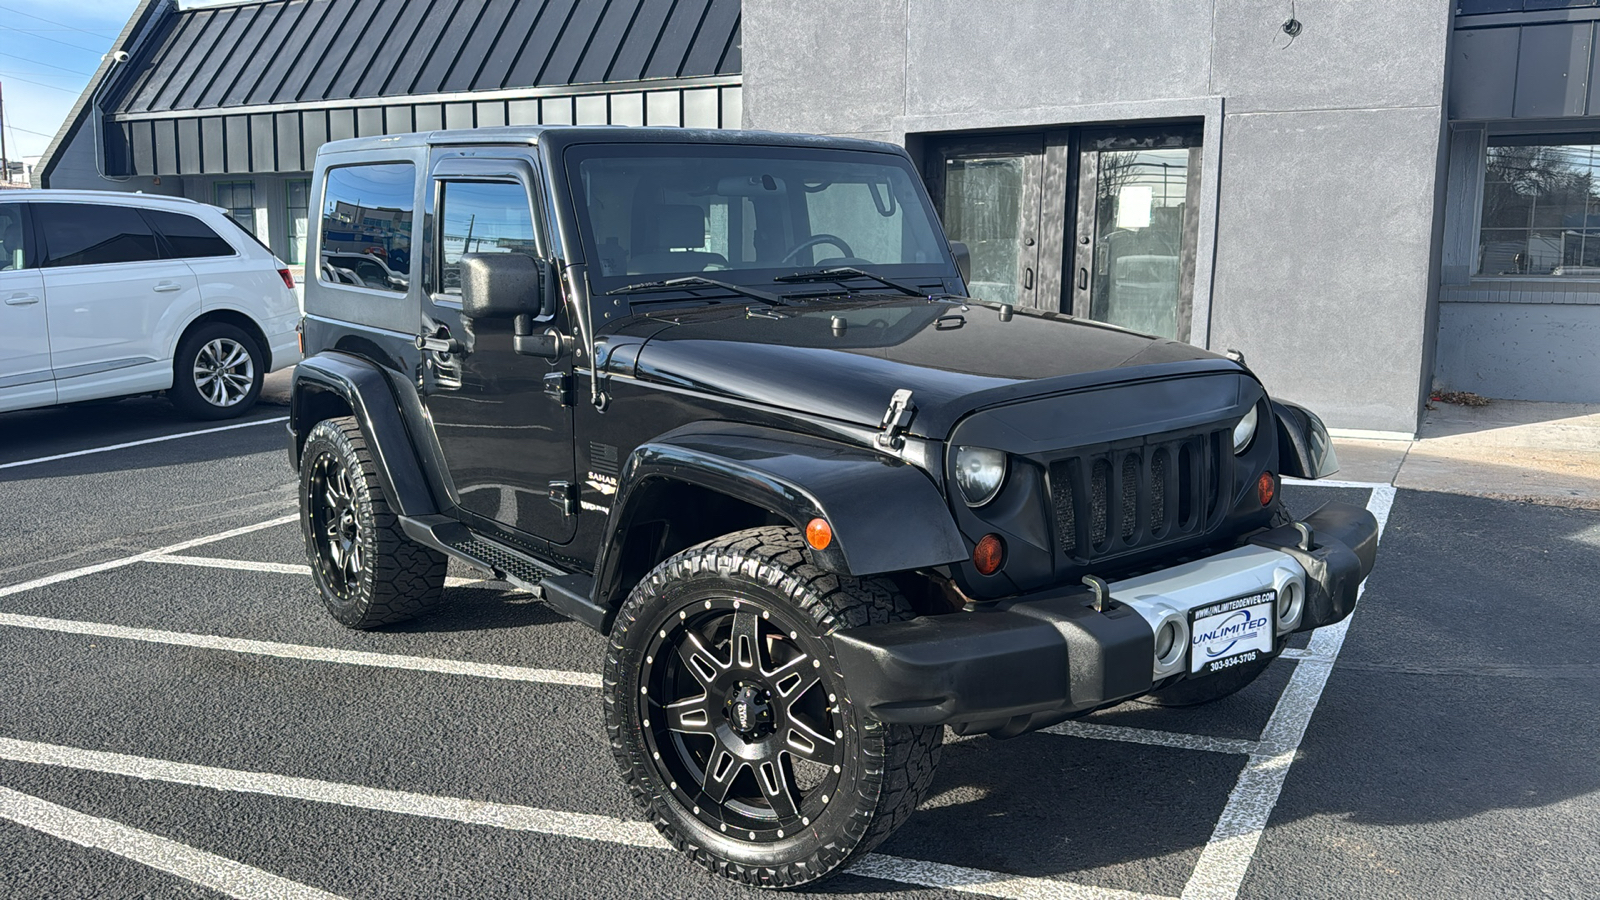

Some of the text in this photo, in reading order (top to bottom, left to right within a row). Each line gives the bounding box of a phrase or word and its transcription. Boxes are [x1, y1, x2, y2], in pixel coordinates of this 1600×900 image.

[588, 471, 617, 486] SAHAR
[1195, 592, 1275, 619] WWW.UNLIMITEDDENVER.COM
[1193, 617, 1267, 644] UNLIMITED
[1210, 652, 1256, 672] 303-934-3705
